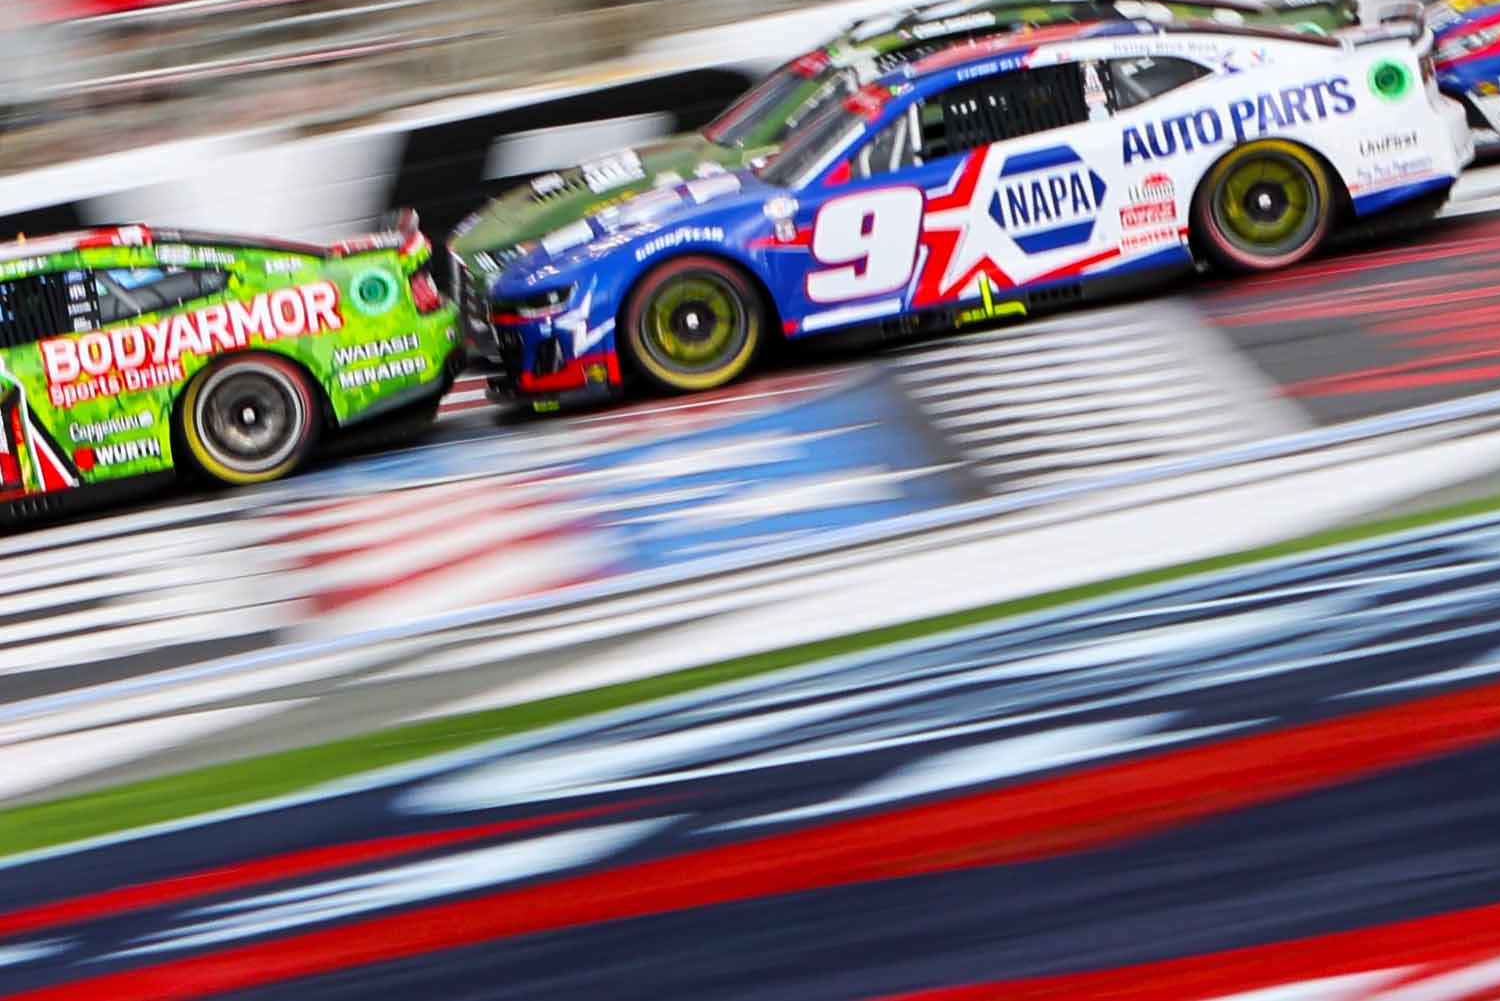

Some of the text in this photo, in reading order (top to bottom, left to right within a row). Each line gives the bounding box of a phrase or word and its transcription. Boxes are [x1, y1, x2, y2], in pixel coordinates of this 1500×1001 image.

[1121, 76, 1357, 165] AUTO PARTS
[1006, 171, 1091, 228] NAPA
[805, 184, 926, 303] 9
[42, 282, 342, 383] BODYARMOR
[334, 333, 420, 366] WABASH
[51, 360, 183, 407] Sports Drink
[339, 355, 427, 390] MENARDS
